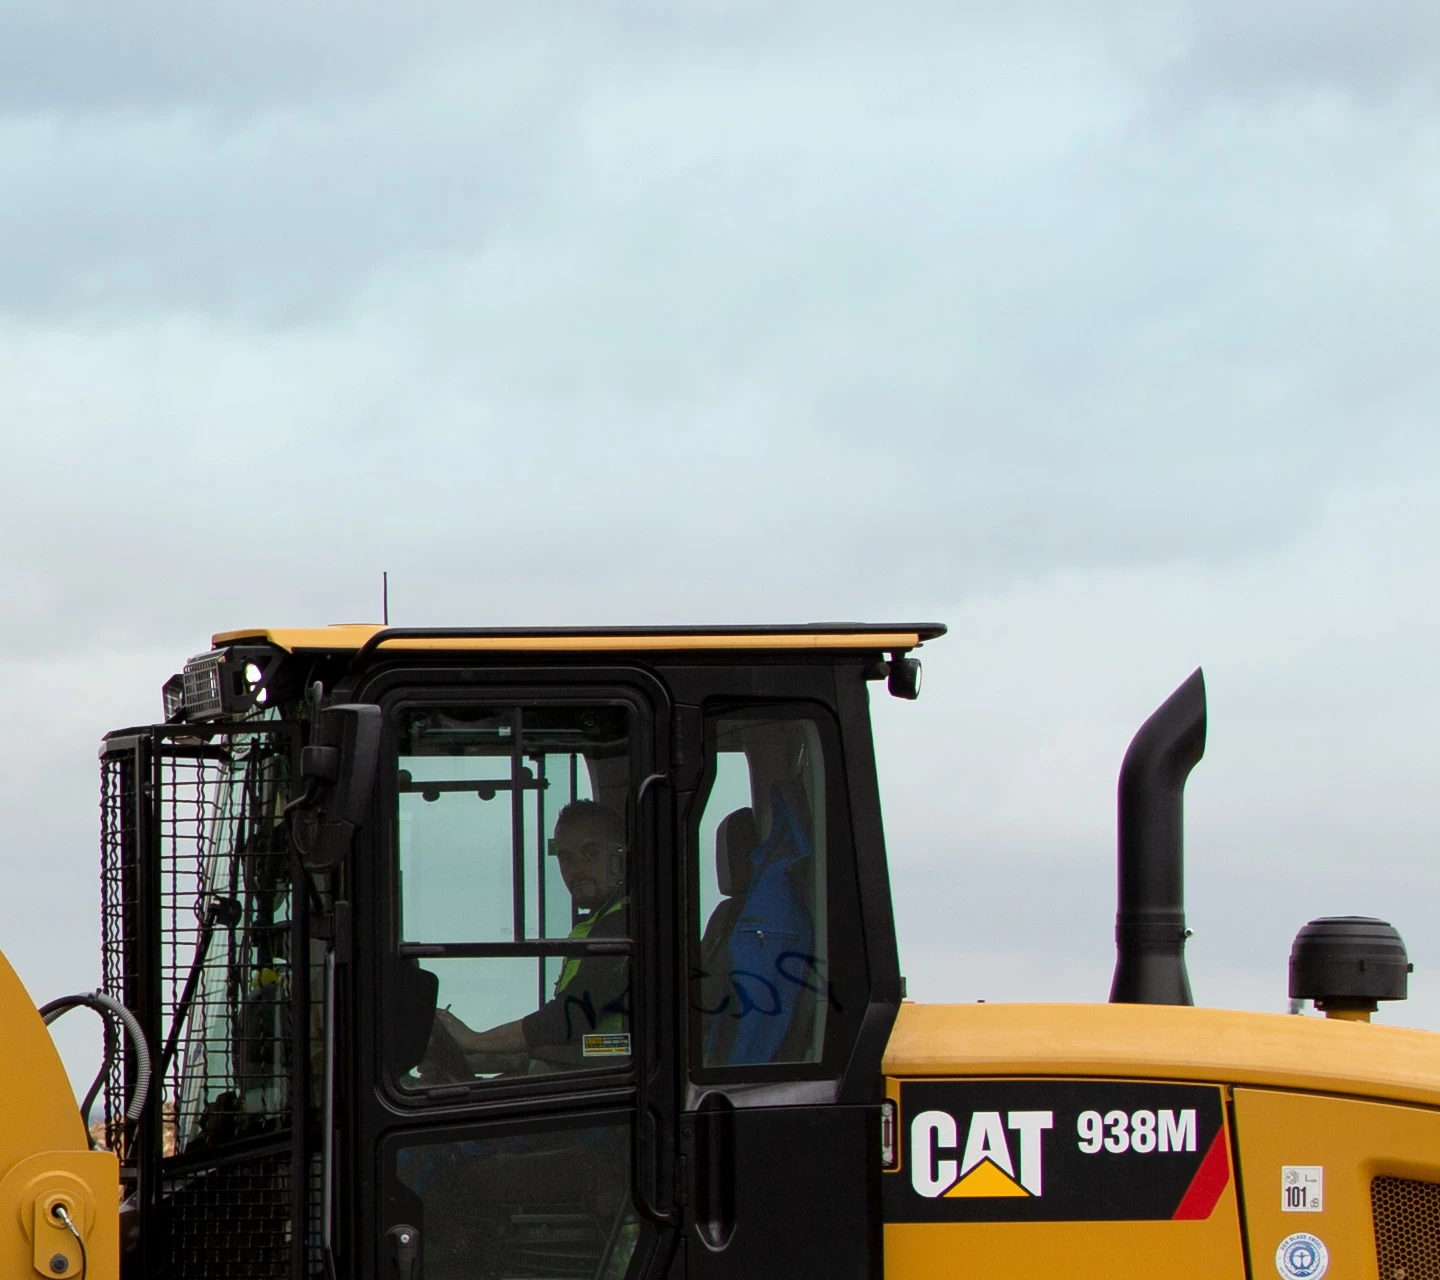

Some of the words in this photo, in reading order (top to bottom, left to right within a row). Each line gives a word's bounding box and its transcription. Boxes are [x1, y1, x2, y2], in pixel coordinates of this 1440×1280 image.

[910, 1110, 1054, 1198] CAT
[1077, 1109, 1197, 1153] 938M
[1285, 1186, 1307, 1207] 101
